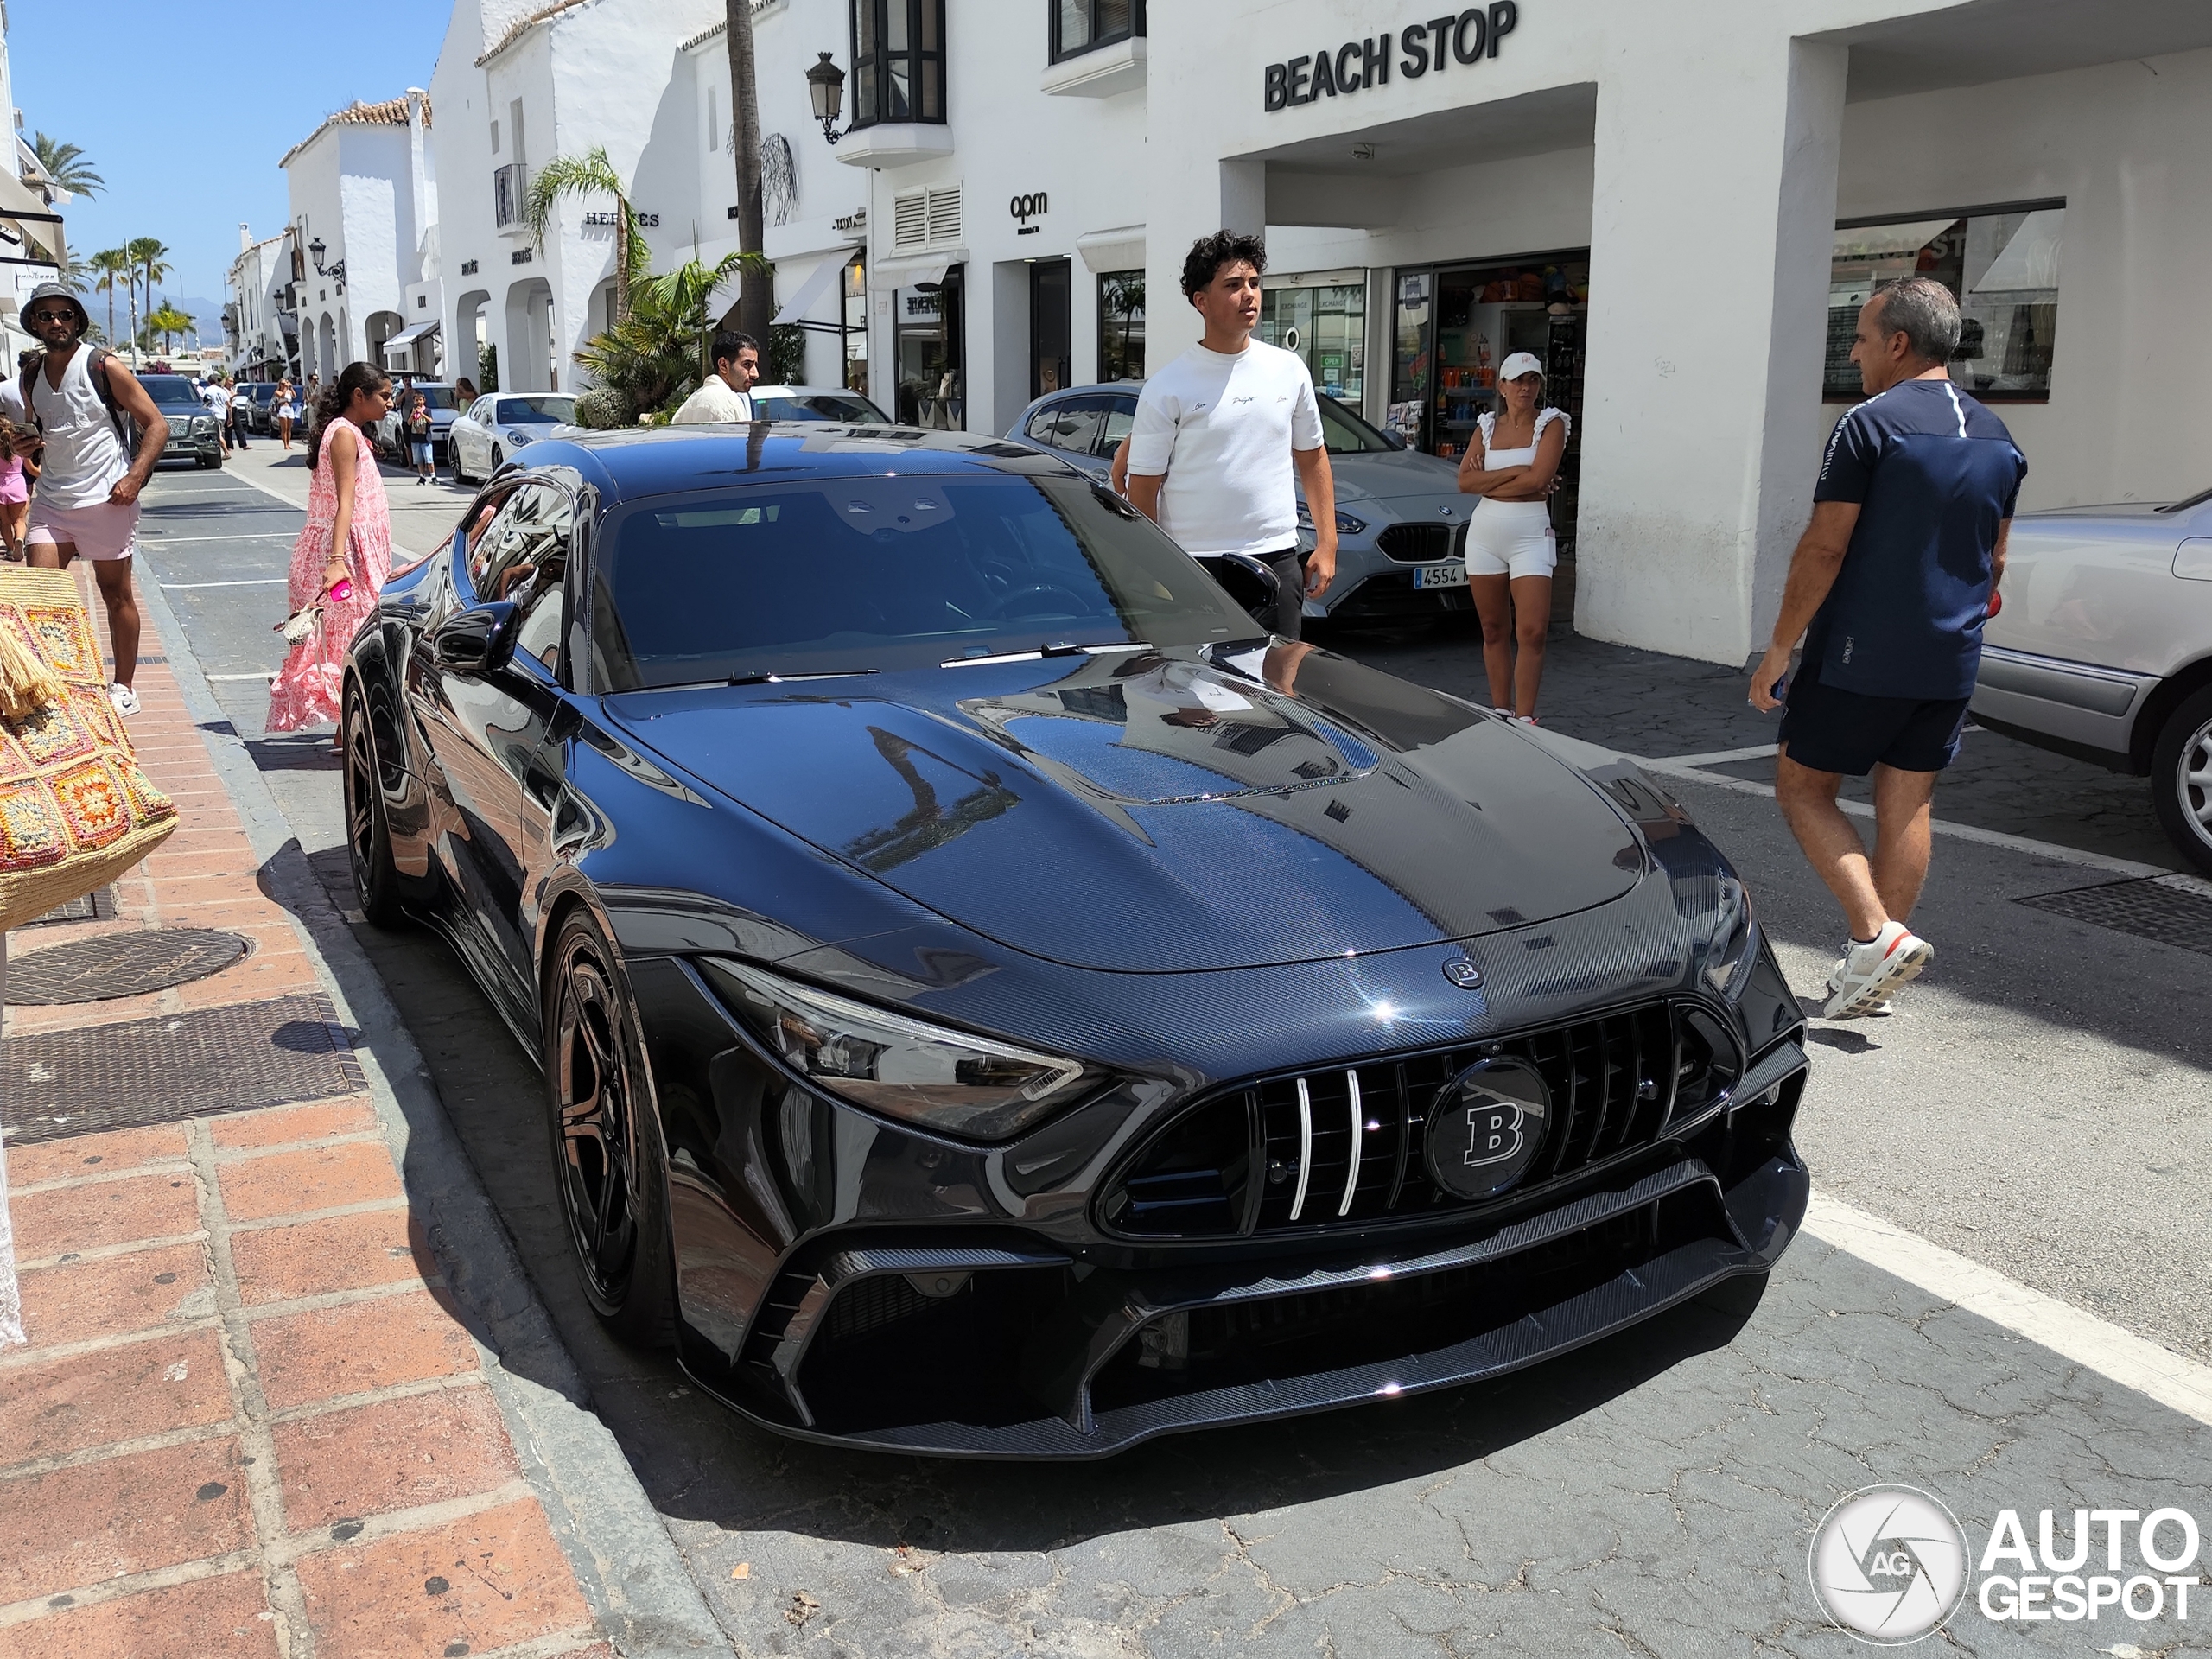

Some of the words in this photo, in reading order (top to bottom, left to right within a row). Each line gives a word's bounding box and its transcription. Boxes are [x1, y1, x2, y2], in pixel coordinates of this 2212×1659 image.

[1264, 33, 1391, 112] BEACH
[1400, 0, 1517, 79] STOP
[1010, 191, 1047, 225] apm
[1281, 302, 1308, 310] EXCHANGE
[1319, 299, 1346, 308] EXCHANGE
[1325, 357, 1339, 365] OPEN
[1424, 568, 1458, 586] 4554
[1448, 963, 1479, 982] B
[1463, 1101, 1525, 1167] B
